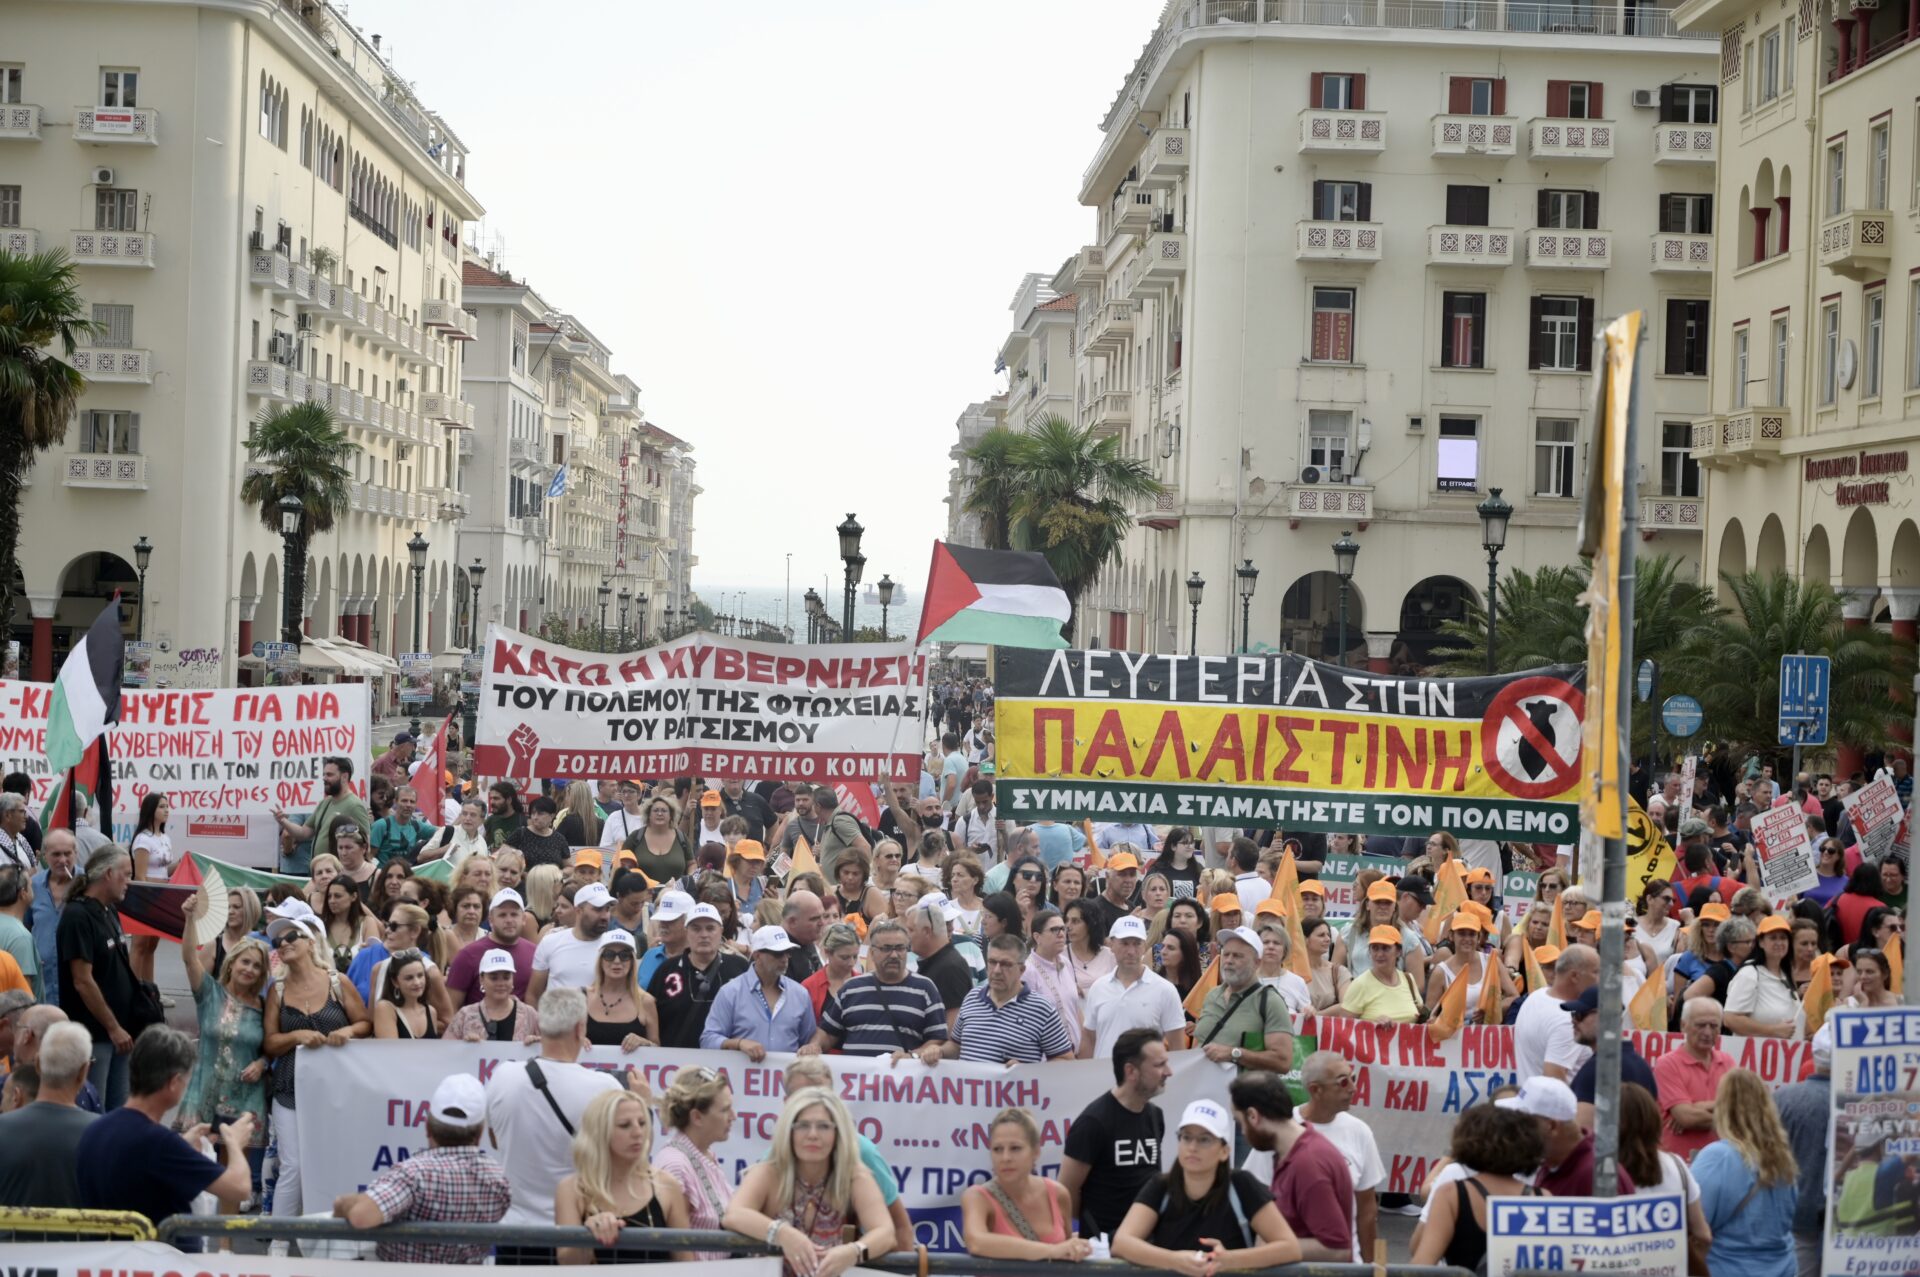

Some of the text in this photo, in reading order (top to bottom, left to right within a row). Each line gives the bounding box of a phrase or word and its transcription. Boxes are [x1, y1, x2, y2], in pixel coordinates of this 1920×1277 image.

[493, 639, 926, 689] ΚΑΤΩ Η ΚΥΒΕΡΝΗΣΗ
[493, 684, 559, 711] ΤΟΥ
[697, 688, 760, 713] ΤΗΣ
[1038, 648, 1455, 717] ΛΕΥΤΕΡΙΑ ΣΤΗΝ
[233, 692, 282, 723] ΓΙΑ
[296, 691, 340, 720] ΝΑ
[109, 729, 223, 759] ΚΥΒΕΡΝΗΣΗ
[232, 730, 263, 759] ΤΟΥ
[272, 724, 355, 757] ΘΑΝΑΤΟΥ
[607, 716, 820, 743] ΤΟΥ ΡΑΤΣΙΣΜΟΥ
[556, 752, 907, 777] ΣΟΣΙΑΛΙΣΤΙΚΟ ΕΡΓΑΤΙΚΟ ΚΟΜΜΑ
[1033, 707, 1472, 791] ΠΑΛΑΙΣΤΙΝΗ
[9, 758, 48, 774] ΤΗΝ
[149, 763, 181, 780] ΟΧΙ
[191, 763, 219, 780] ΓΙΑ
[224, 762, 259, 780] ΤΟΝ
[1012, 788, 1569, 834] ΣΥΜΜΑΧΙΑ ΣΤΑΜΑΤΗΣΤΕ ΤΟΝ ΠΟΛΕΜΟ
[664, 972, 684, 997] 3
[1856, 1055, 1896, 1093] ΔΕΘ
[1903, 1067, 1918, 1091] 7
[1384, 1080, 1429, 1112] ΚΑΙ
[1497, 1201, 1679, 1234] ΓΣΕΕ-ΕΚΘ
[1515, 1238, 1676, 1271] ΔΕΘ ΣΥΛΛΑΛΗΤΗΡΙΟ
[1570, 1257, 1641, 1273] 7 ΣΑΒΒΑΤΟ
